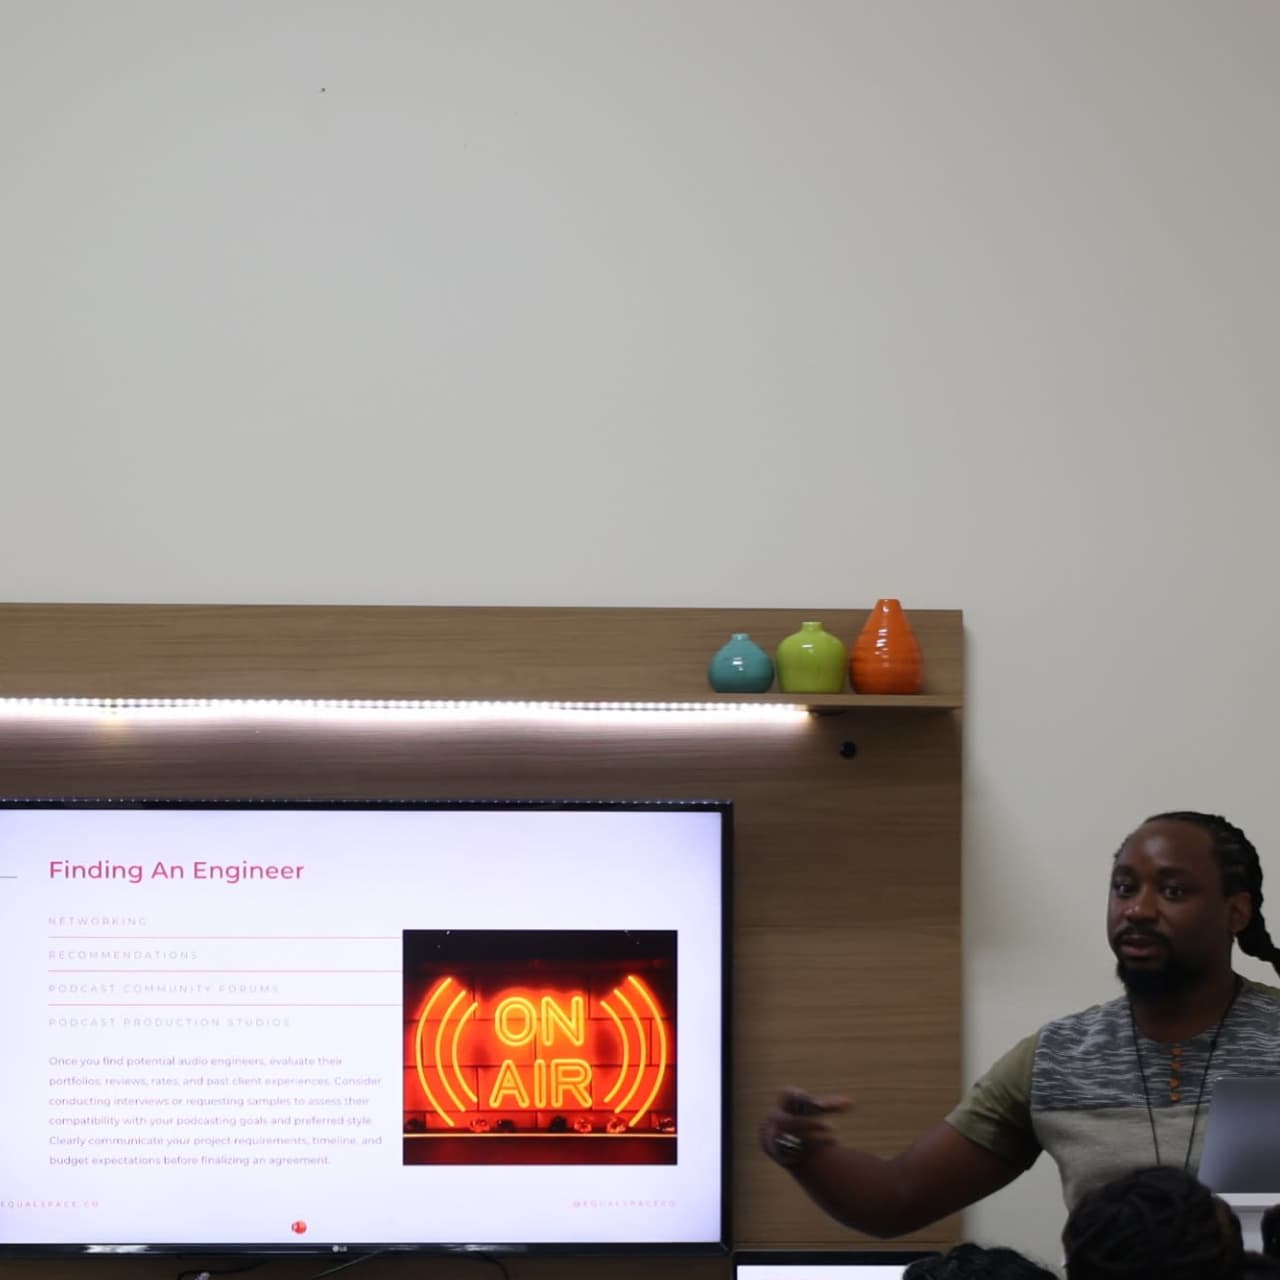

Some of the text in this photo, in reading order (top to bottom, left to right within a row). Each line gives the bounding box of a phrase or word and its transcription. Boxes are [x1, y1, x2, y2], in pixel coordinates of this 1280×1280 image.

[49, 860, 304, 883] Finding An Engineer
[48, 917, 148, 926] NETWORKING
[48, 951, 198, 960] RECOMMENDATIONS
[48, 984, 279, 993] PODCAST COMMUNITY FORUMS
[48, 1018, 290, 1027] PODCAST PRODUCTION STUDIOS
[494, 996, 585, 1047] ON
[49, 1056, 78, 1066] Once
[80, 1059, 100, 1068] you
[102, 1056, 124, 1066] find
[126, 1056, 175, 1068] potential
[178, 1056, 208, 1066] audio
[269, 1056, 315, 1066] evaluate
[318, 1056, 342, 1066] their
[183, 1076, 203, 1086] and
[206, 1076, 230, 1088] past
[232, 1076, 262, 1086] client
[334, 1076, 382, 1086] Consider
[489, 1058, 593, 1109] AIR
[49, 1096, 111, 1108] conducting
[114, 1096, 169, 1106] interviews
[186, 1096, 244, 1108] requesting
[247, 1096, 291, 1108] samples
[294, 1096, 305, 1106] to
[344, 1096, 369, 1106] their
[49, 1116, 120, 1128] compatibility
[122, 1116, 147, 1126] with
[150, 1118, 174, 1128] your
[176, 1116, 237, 1128] podcasting
[240, 1116, 268, 1128] goals
[271, 1116, 291, 1126] and
[293, 1116, 344, 1128] preferred
[49, 1136, 87, 1148] Clearly
[88, 1136, 164, 1145] communicate
[166, 1138, 191, 1148] your
[193, 1136, 231, 1148] project
[362, 1136, 382, 1145] and
[49, 1156, 88, 1168] budget
[91, 1156, 161, 1168] expectations
[163, 1156, 198, 1165] before
[201, 1156, 250, 1168] finalizing
